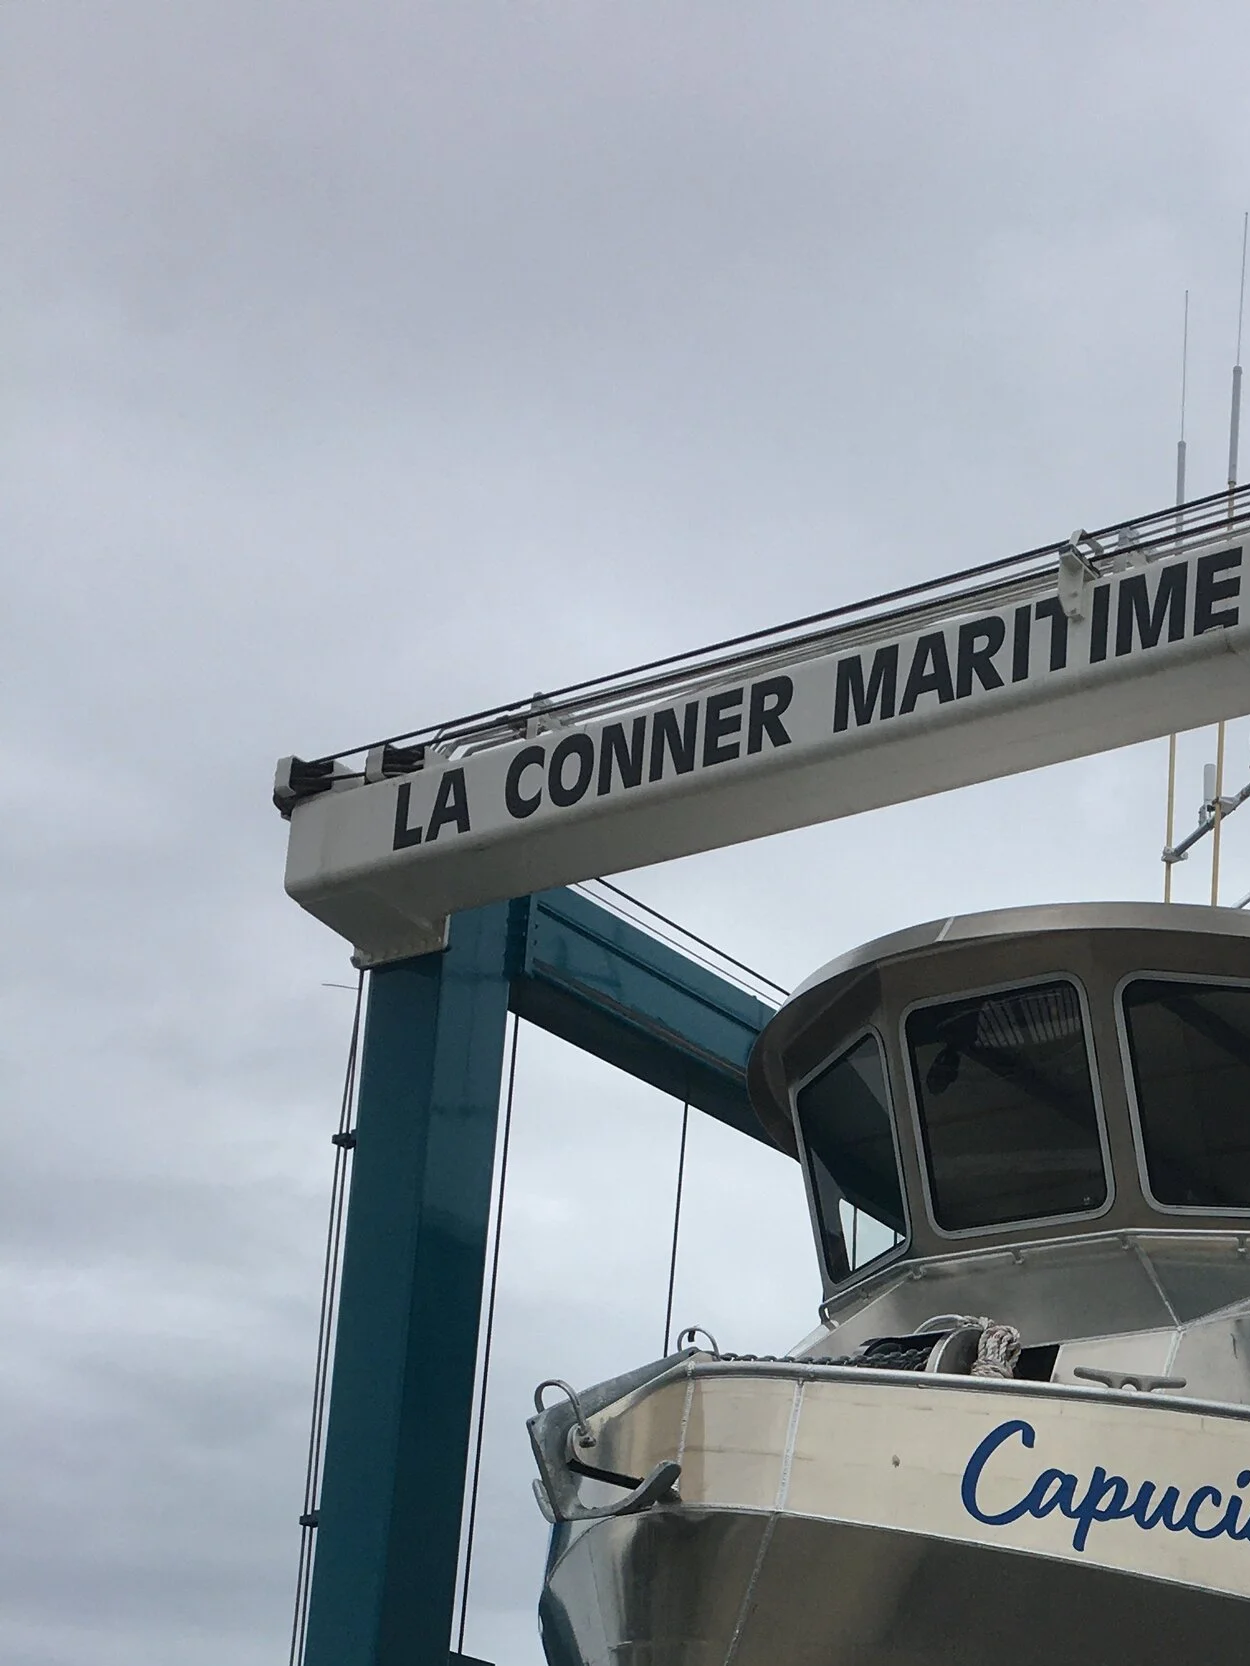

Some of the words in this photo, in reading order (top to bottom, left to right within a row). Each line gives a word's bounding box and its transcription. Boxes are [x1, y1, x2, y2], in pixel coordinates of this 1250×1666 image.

[392, 767, 470, 851] LA
[505, 675, 794, 819] CONNER
[833, 546, 1243, 733] MARITIME
